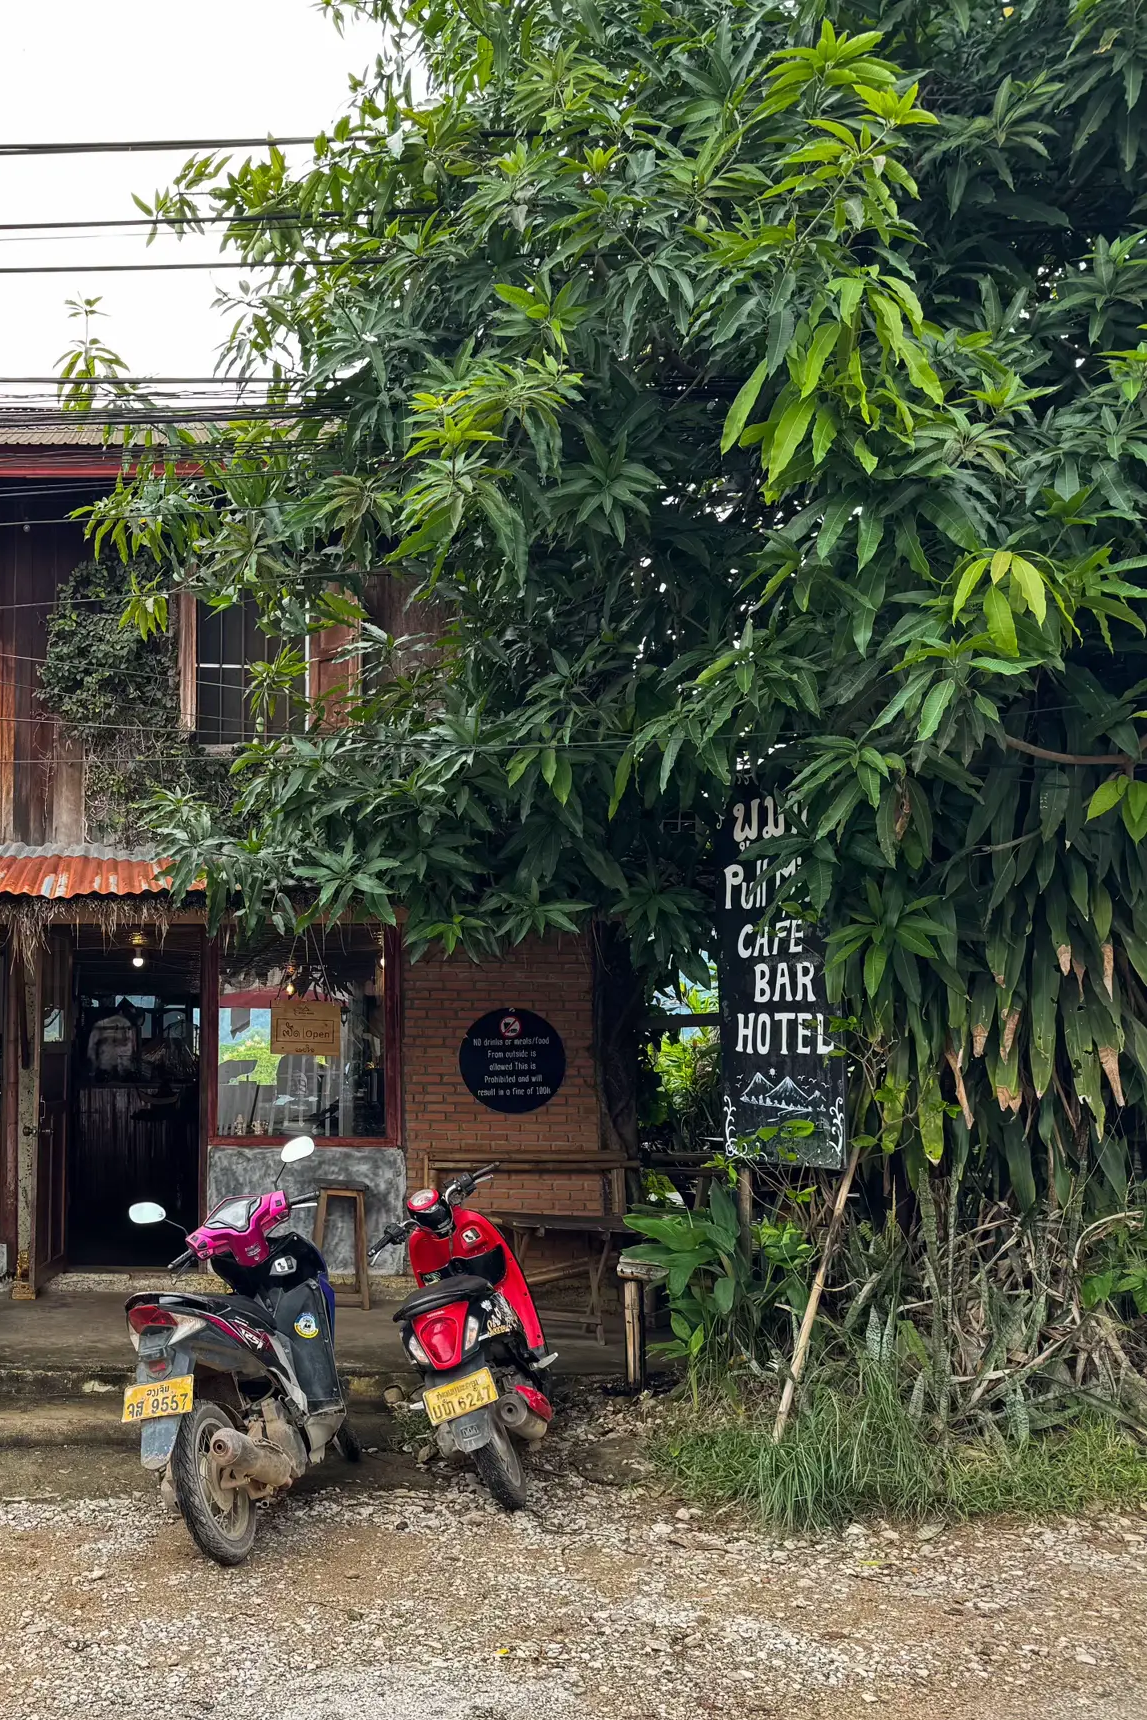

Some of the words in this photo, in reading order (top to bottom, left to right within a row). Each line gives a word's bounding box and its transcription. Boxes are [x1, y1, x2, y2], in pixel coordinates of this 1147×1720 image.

[723, 858, 769, 910] Pull
[753, 962, 816, 1003] BAR
[305, 1029, 330, 1040] Open
[735, 1012, 834, 1055] HOTEL
[483, 1038, 503, 1046] drinks
[487, 1050, 503, 1058] From
[505, 1050, 528, 1058] outside
[530, 1050, 536, 1058] is
[489, 1062, 512, 1070] allowed
[514, 1062, 528, 1070] This
[530, 1061, 536, 1069] is
[484, 1075, 515, 1083] Prohibited
[517, 1075, 529, 1083] and
[531, 1074, 542, 1082] will
[477, 1088, 495, 1096] result
[498, 1088, 505, 1096] in
[512, 1087, 525, 1095] fine
[527, 1087, 534, 1095] of
[458, 1385, 490, 1410] 6247
[152, 1393, 189, 1414] 9557
